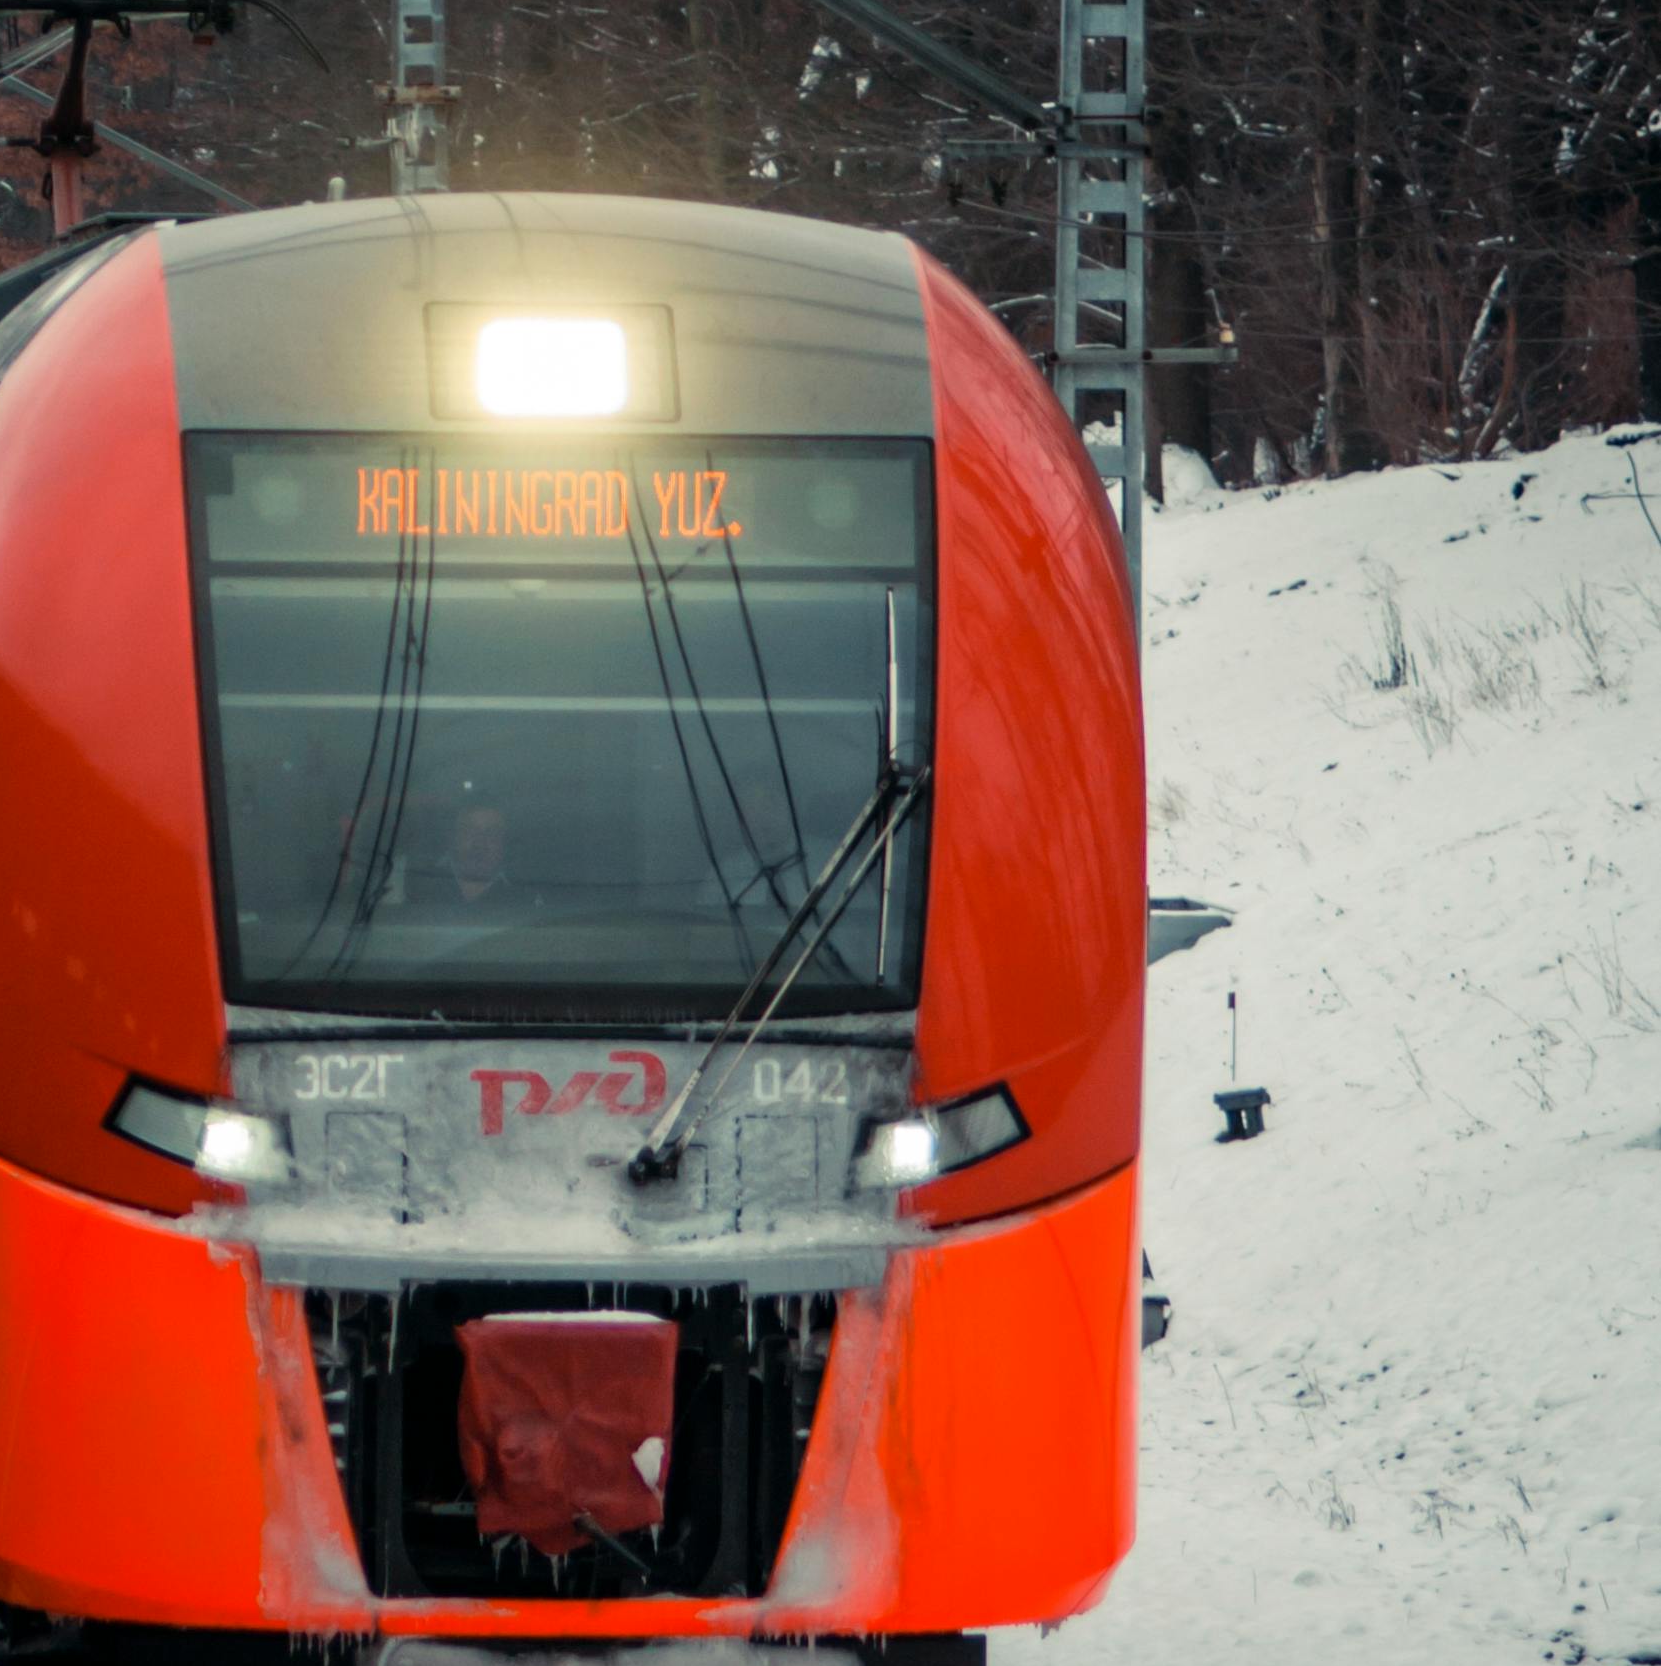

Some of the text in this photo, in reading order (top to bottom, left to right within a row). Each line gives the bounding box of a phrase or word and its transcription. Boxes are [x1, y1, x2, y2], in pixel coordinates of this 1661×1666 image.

[357, 468, 743, 538] KALININGRAD YUZ.
[294, 1054, 404, 1100] ЭС2Г
[753, 1058, 847, 1104] 042
